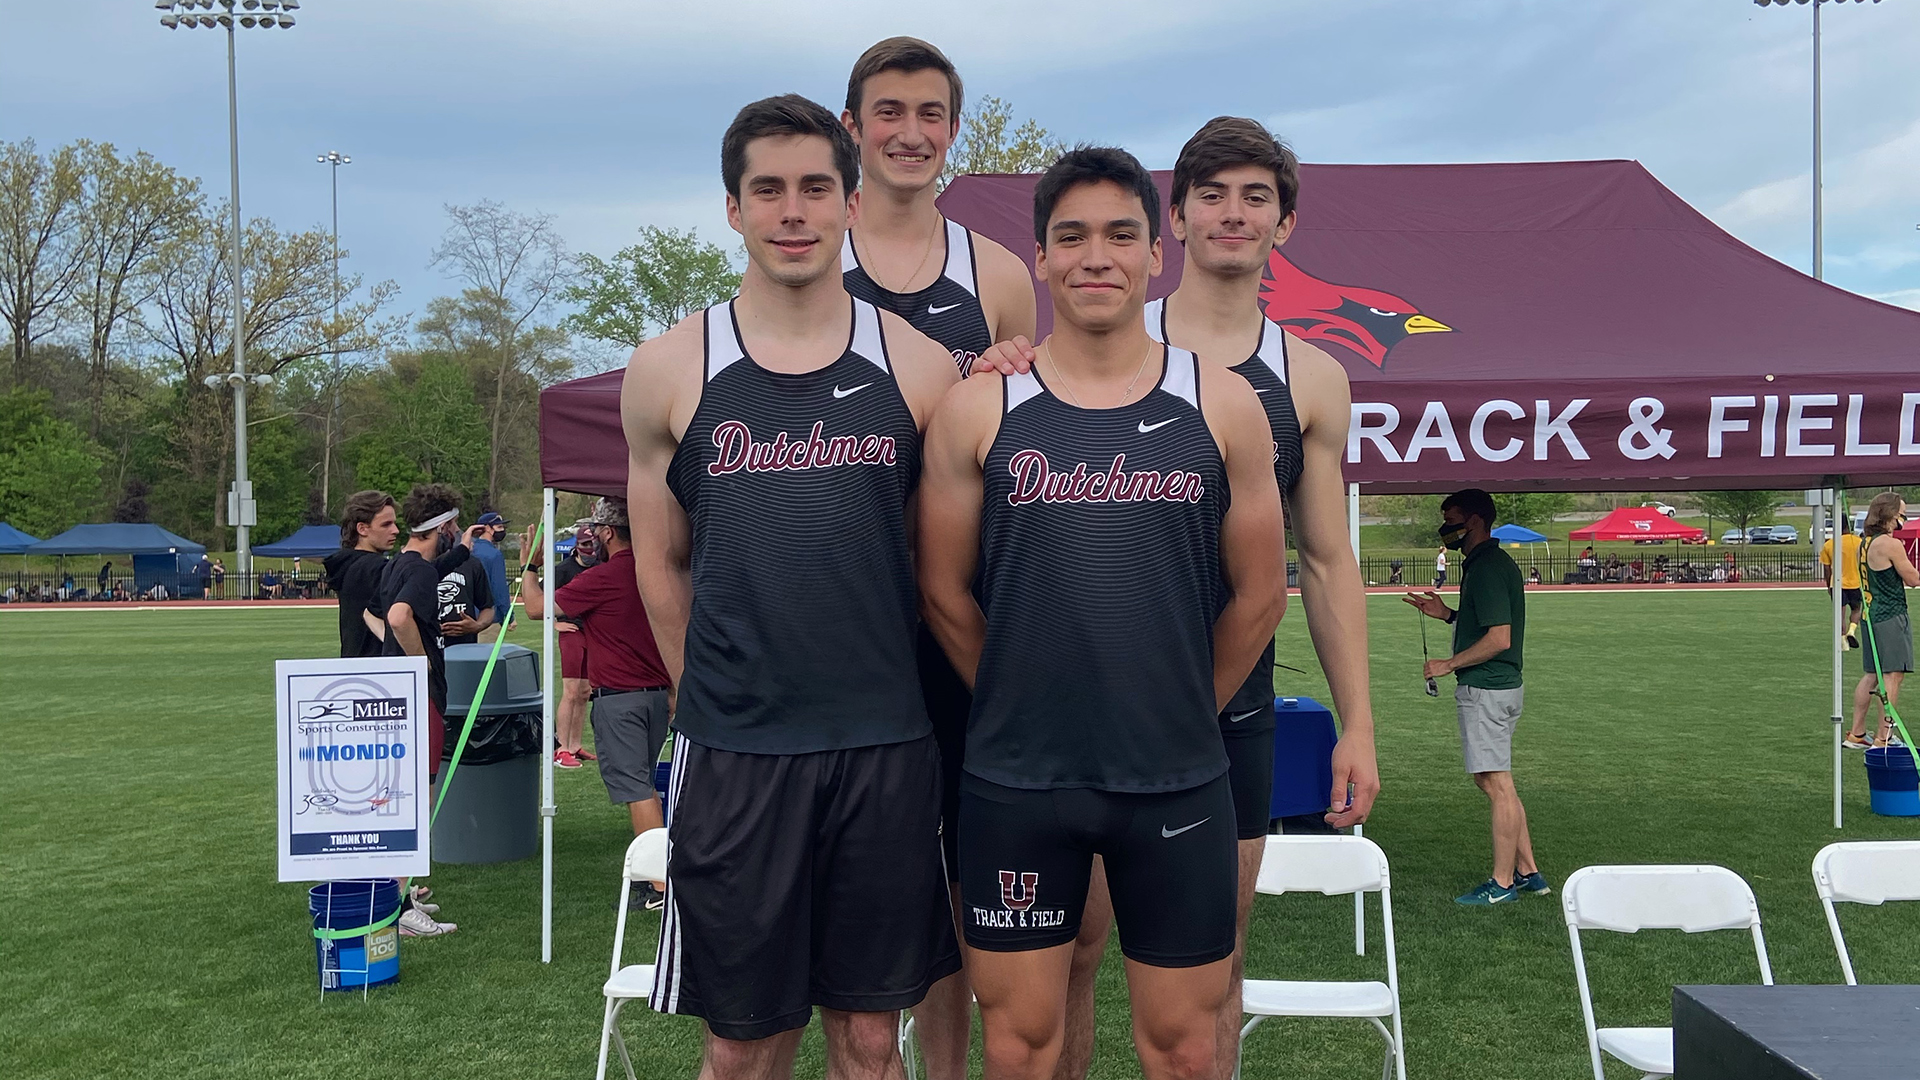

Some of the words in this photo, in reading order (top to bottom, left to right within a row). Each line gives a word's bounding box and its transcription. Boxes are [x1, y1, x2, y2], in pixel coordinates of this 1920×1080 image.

[1347, 398, 1592, 464] RACK
[1617, 396, 1677, 461] &
[708, 420, 897, 476] Dutchmen
[1008, 449, 1205, 506] Dutchmen
[355, 701, 406, 718] Miller
[298, 724, 333, 736] Sports
[335, 722, 408, 733] Construction
[316, 743, 406, 761] MONDO
[330, 834, 361, 846] THANK
[361, 833, 380, 844] YOU
[999, 870, 1038, 911] U
[973, 907, 1015, 928] TRACK
[1020, 910, 1027, 927] &
[1032, 910, 1065, 927] FIELD
[370, 941, 396, 956] 100
